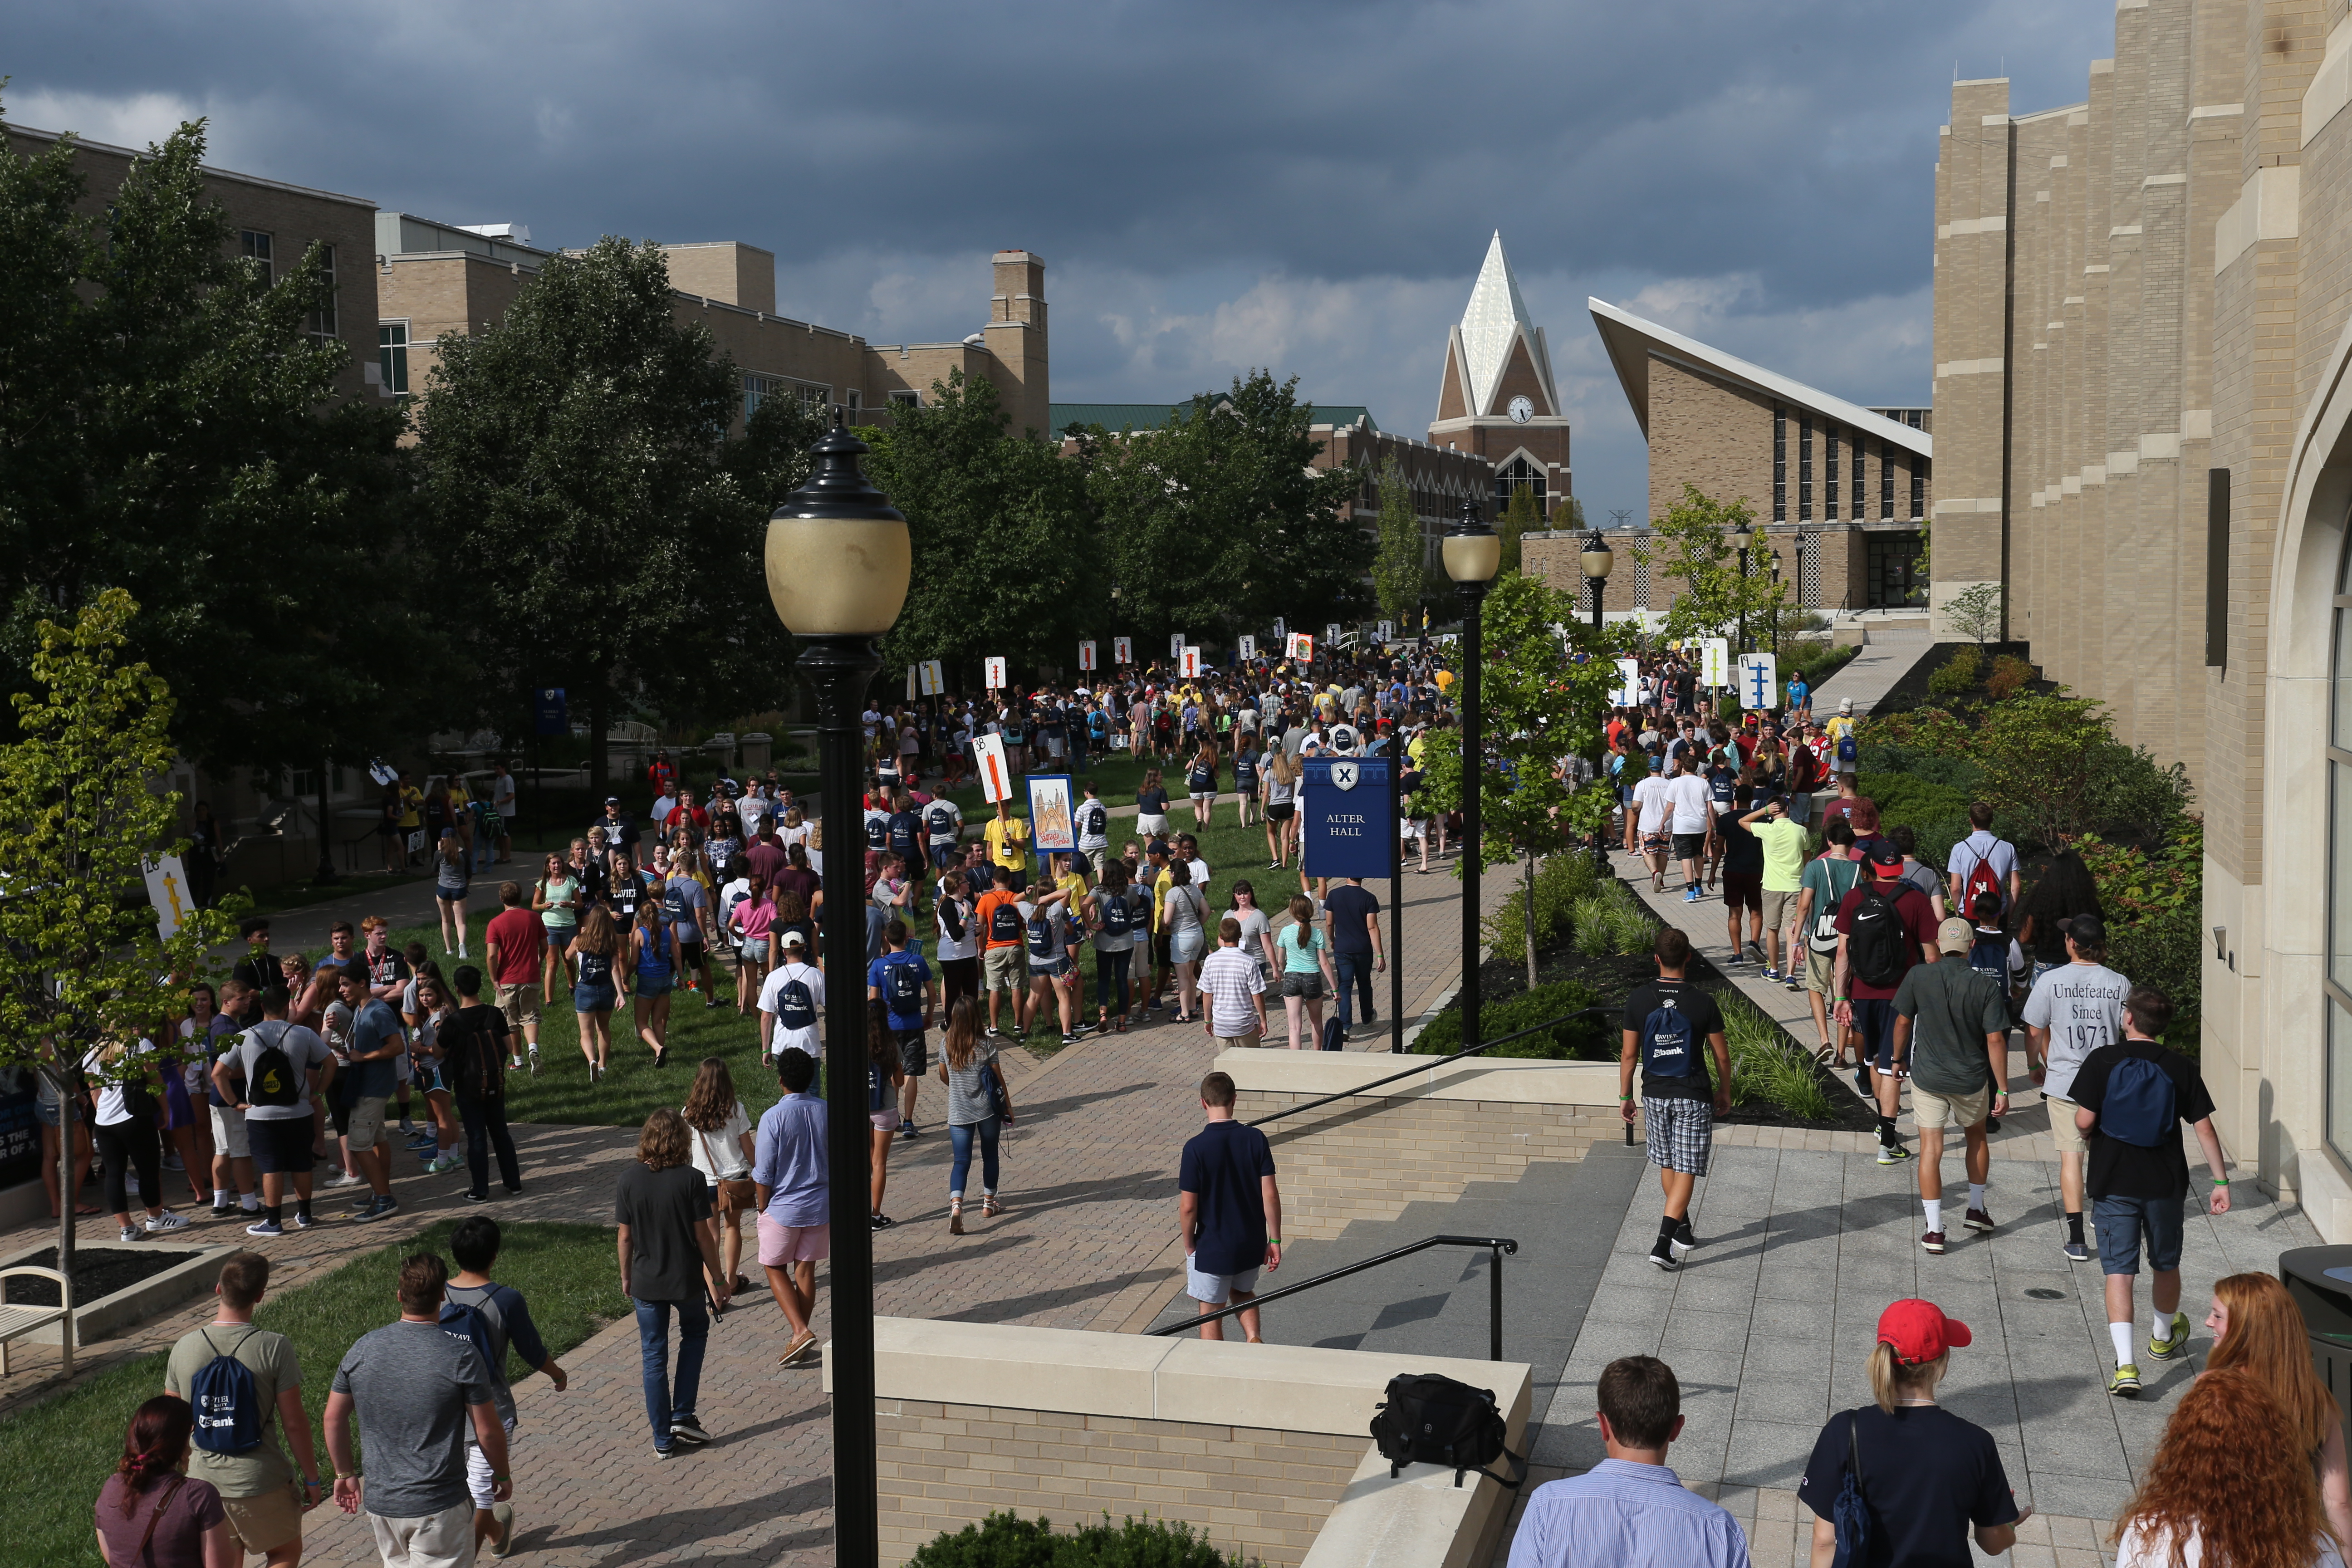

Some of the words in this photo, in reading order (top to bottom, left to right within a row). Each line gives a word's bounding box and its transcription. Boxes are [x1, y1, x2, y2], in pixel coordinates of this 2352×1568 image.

[1704, 639, 1711, 649] 15
[921, 661, 929, 670] 36
[1740, 656, 1749, 667] 19
[974, 737, 986, 752] 38
[1326, 814, 1366, 823] ALTER
[1039, 829, 1060, 844] Sagrada
[1330, 828, 1362, 836] HALL
[1053, 835, 1070, 848] Familia
[143, 856, 159, 874] 26
[2053, 983, 2121, 1000] Undefeated
[2073, 1004, 2102, 1020] Since
[2067, 1025, 2108, 1050] 1973
[1653, 1046, 1684, 1058] sbank
[7, 1129, 29, 1143] THE
[11, 1142, 25, 1155] OF
[28, 1139, 36, 1151] X
[452, 1333, 472, 1342] XAVI
[199, 1414, 235, 1429] usank
